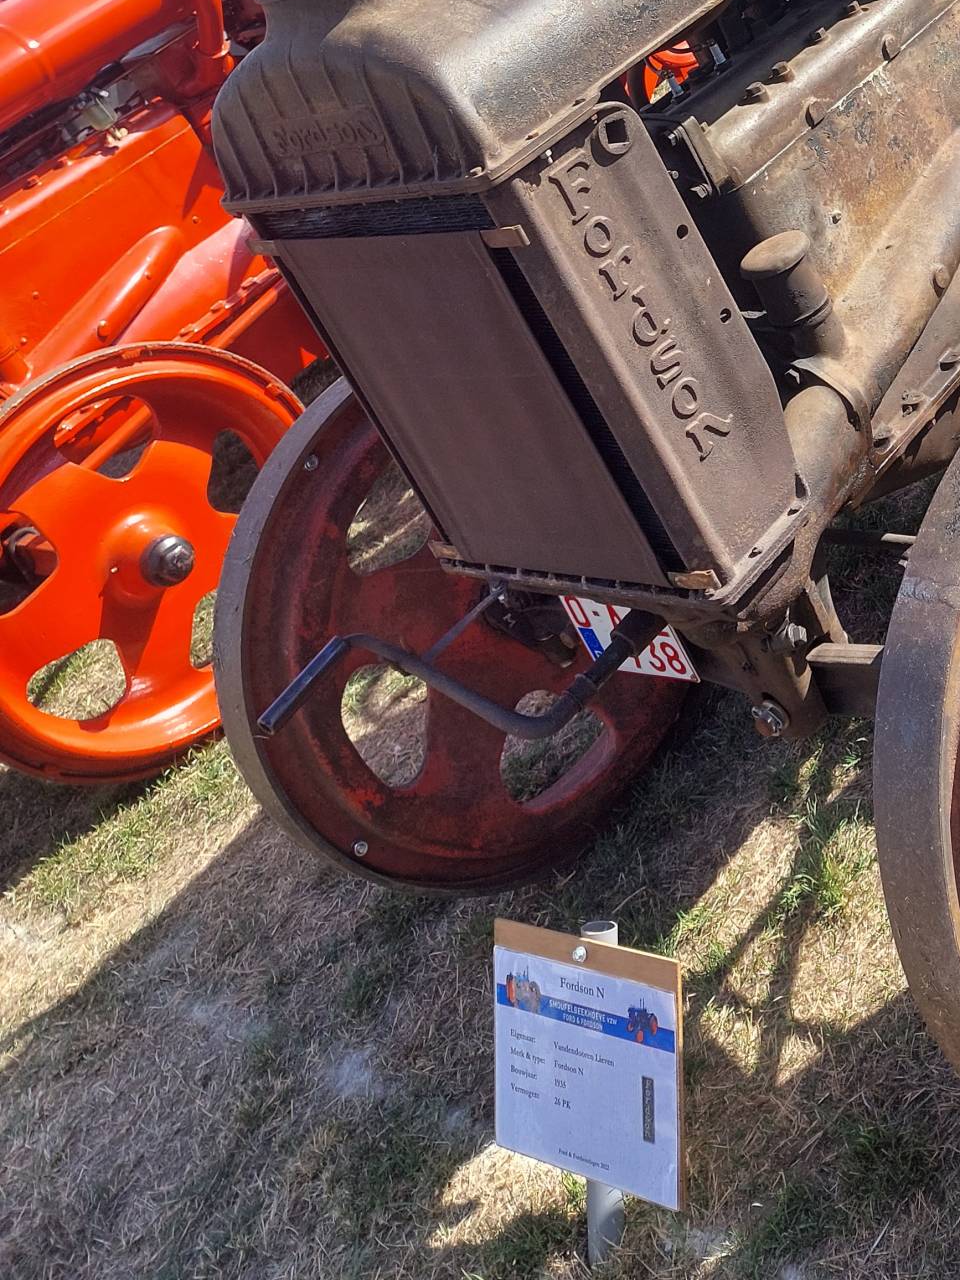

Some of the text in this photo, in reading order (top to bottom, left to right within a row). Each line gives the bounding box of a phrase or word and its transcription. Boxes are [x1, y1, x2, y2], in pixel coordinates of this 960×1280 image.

[560, 976, 605, 999] Fordson N
[510, 1046, 525, 1058] Merk
[553, 1059, 584, 1076] Fordson N
[554, 1096, 571, 1110] 26 PK
